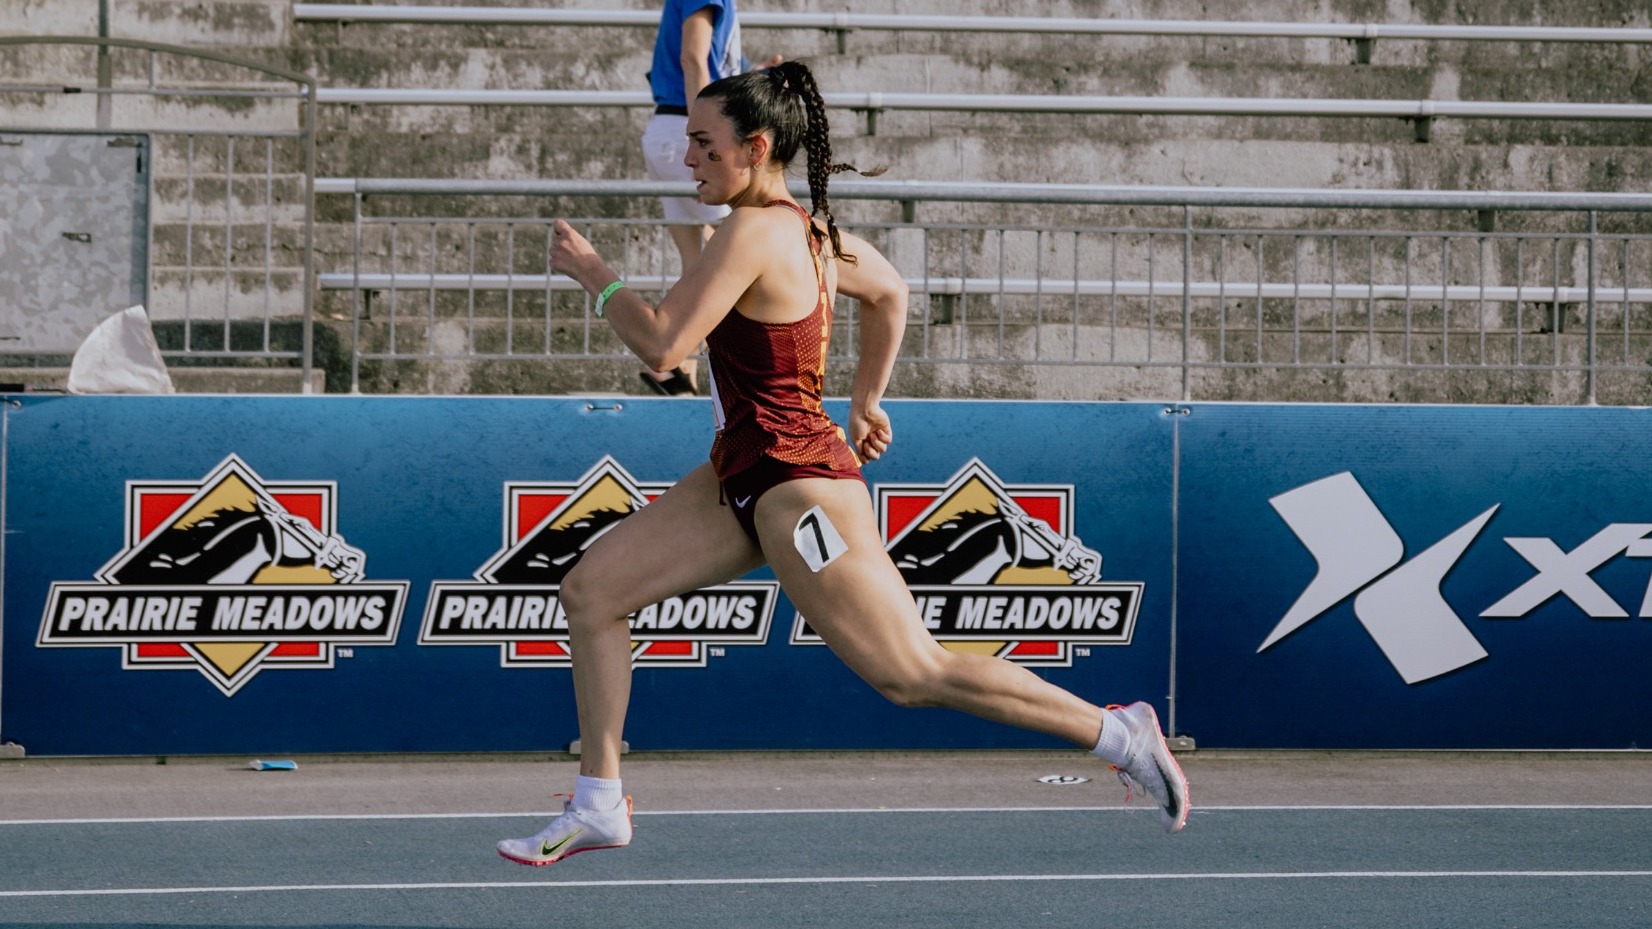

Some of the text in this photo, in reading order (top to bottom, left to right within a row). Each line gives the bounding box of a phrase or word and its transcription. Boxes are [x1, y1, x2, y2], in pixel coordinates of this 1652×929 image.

[798, 512, 830, 563] 7
[57, 596, 387, 631] PRAIRIE MEADOWS
[628, 596, 757, 630] ADOWS
[954, 596, 1122, 630] MEADOWS
[337, 649, 354, 658] TM
[710, 648, 725, 657] TM
[1075, 648, 1091, 657] TM
